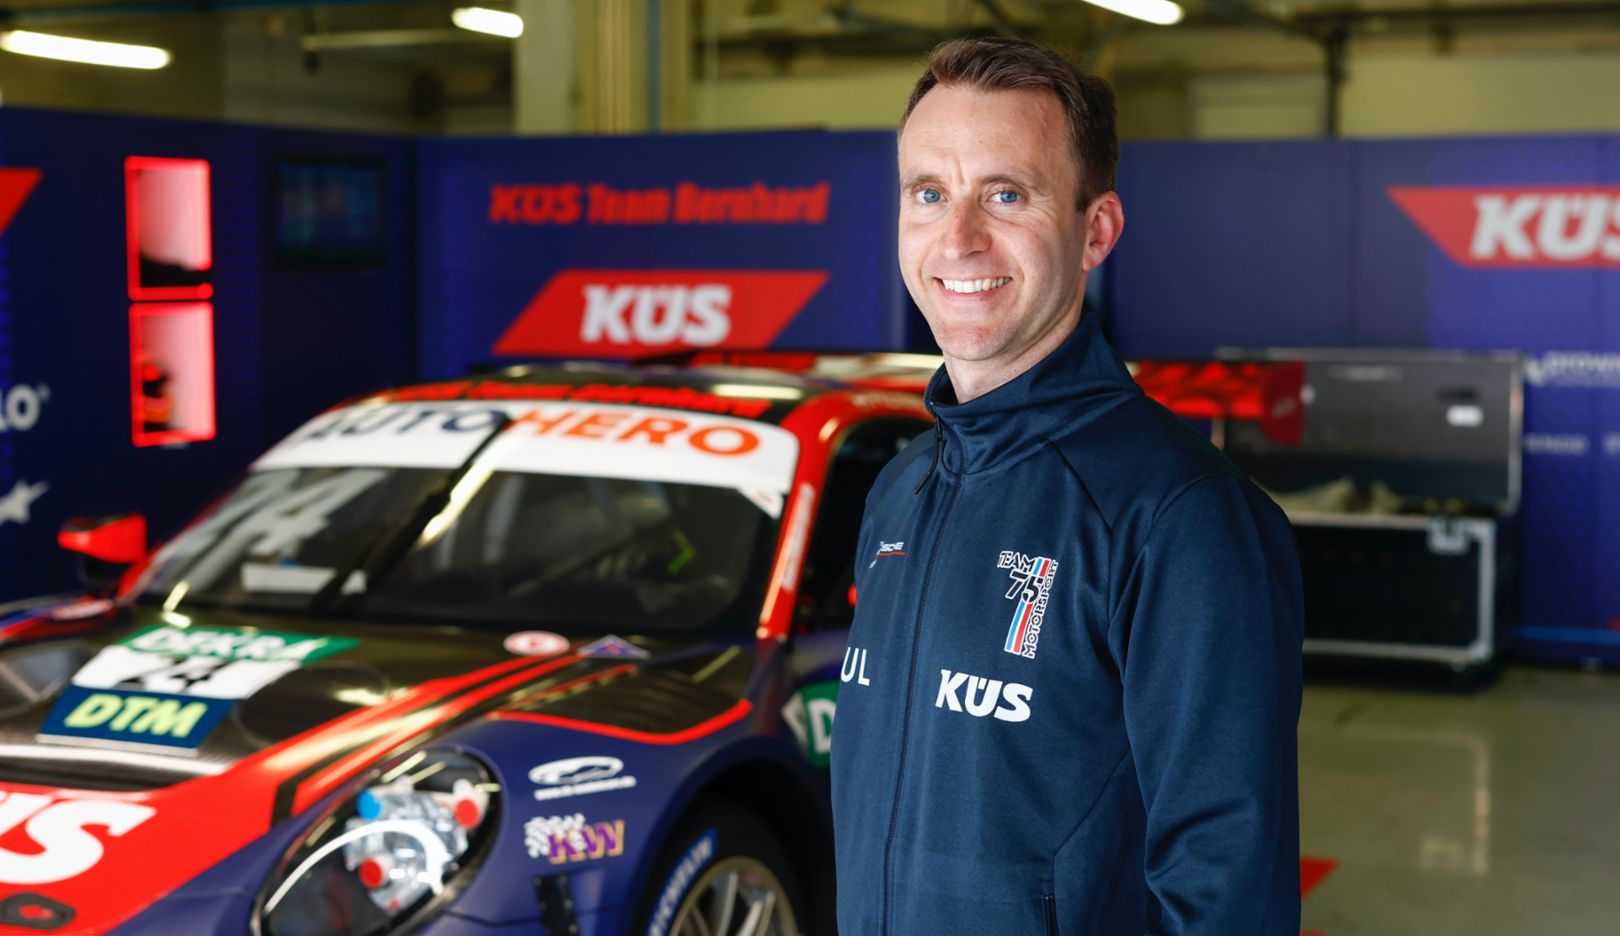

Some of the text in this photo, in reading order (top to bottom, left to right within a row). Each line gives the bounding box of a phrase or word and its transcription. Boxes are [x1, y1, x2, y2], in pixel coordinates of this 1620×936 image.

[997, 550, 1036, 573] TEAM
[1006, 568, 1044, 603] 75
[1021, 559, 1059, 659] MOTORSPORT
[63, 693, 208, 738] DTM
[935, 669, 1033, 722] KÜS
